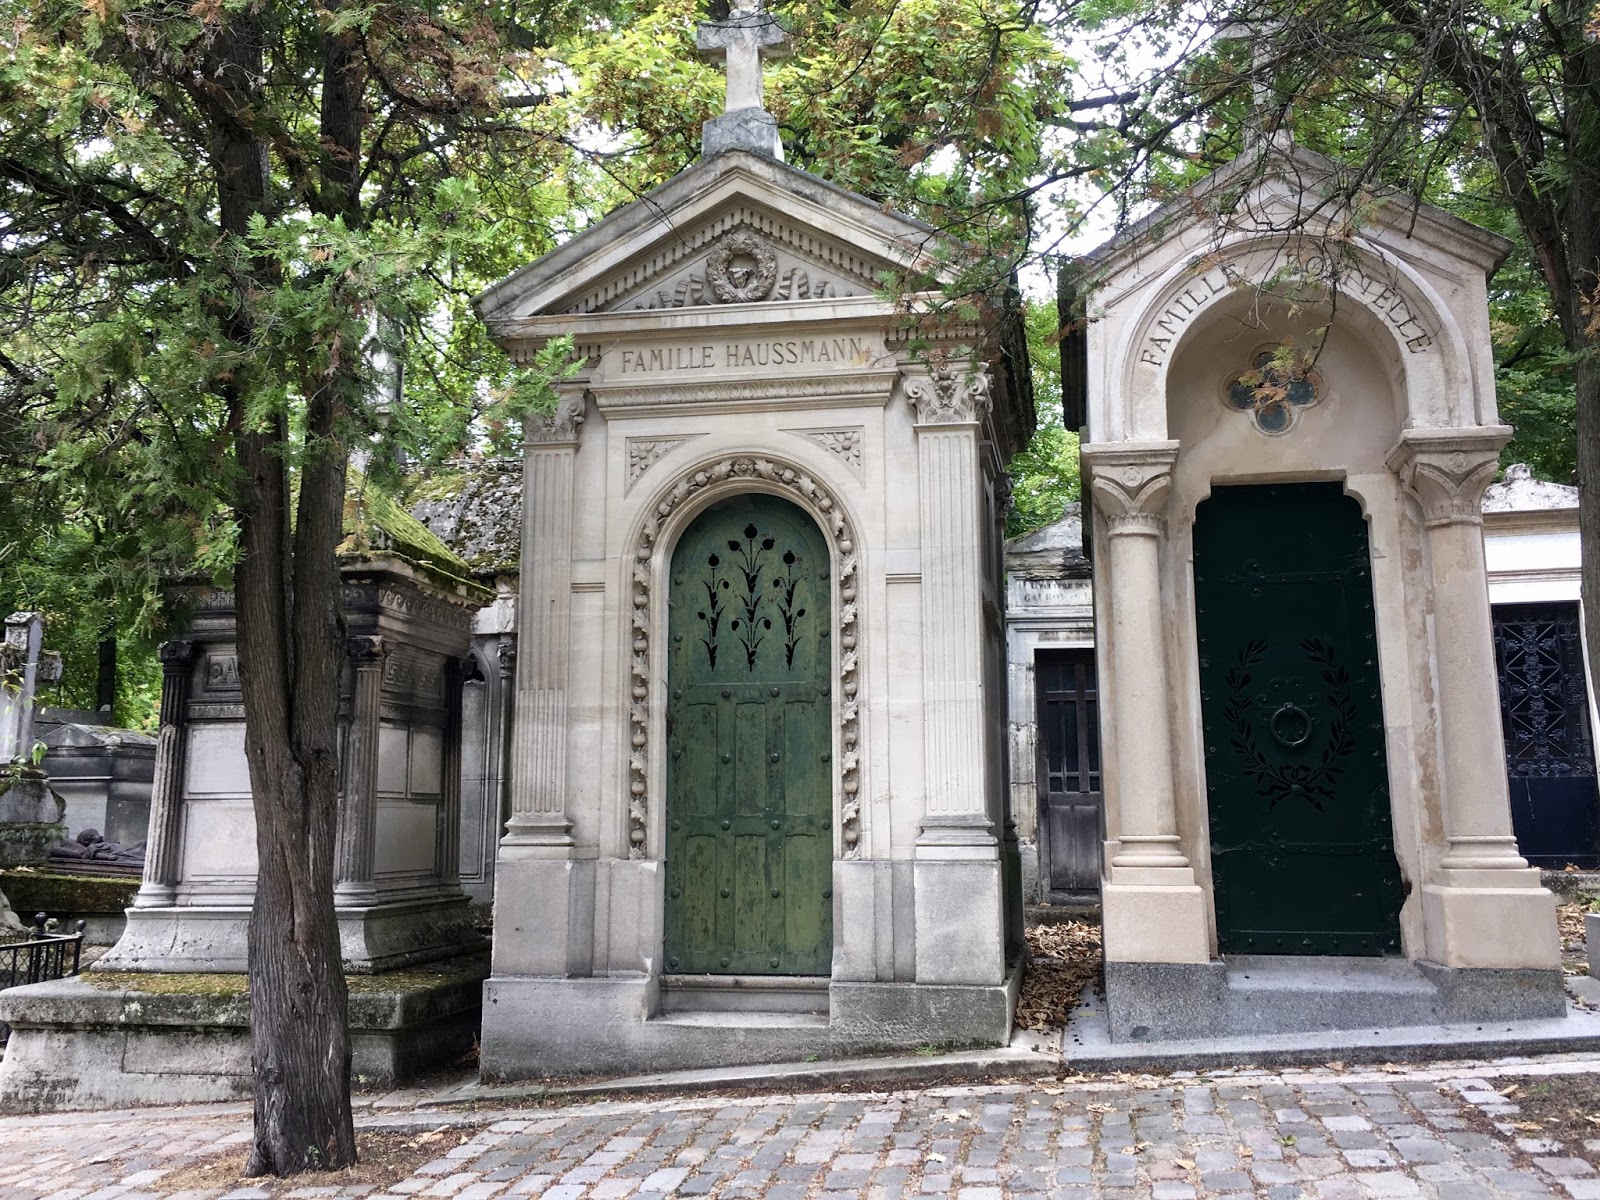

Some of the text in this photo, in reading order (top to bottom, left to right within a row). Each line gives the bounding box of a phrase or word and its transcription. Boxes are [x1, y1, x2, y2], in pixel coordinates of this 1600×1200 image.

[1141, 262, 1237, 368] FAMILLE
[621, 337, 863, 373] FAMILLE HAUSSMANN
